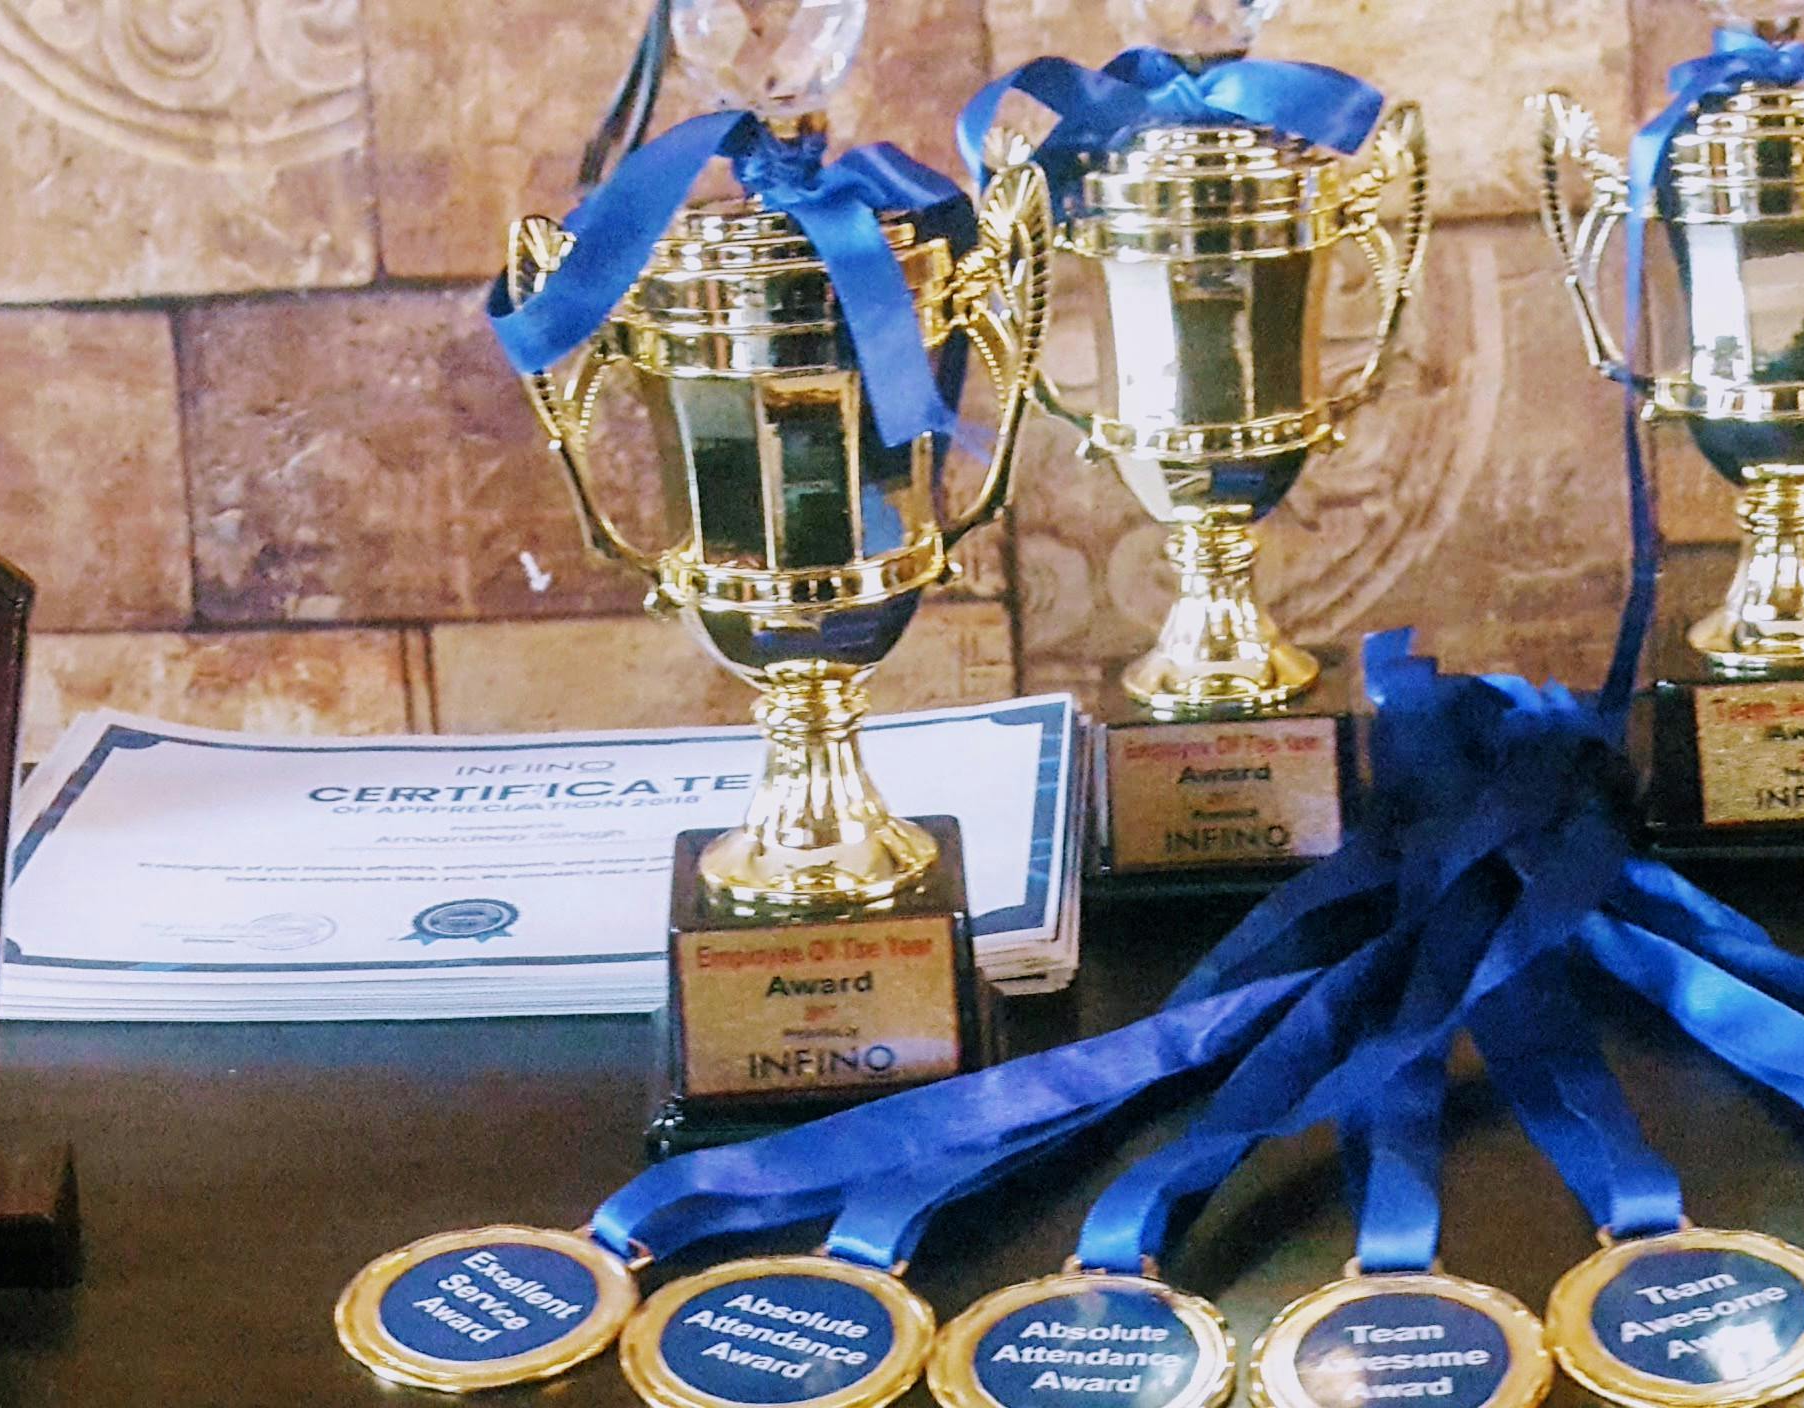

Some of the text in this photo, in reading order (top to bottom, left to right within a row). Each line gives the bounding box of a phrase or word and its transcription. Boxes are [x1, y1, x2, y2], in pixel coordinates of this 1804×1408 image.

[766, 971, 874, 998] Award
[748, 1044, 895, 1080] INFINO
[462, 1251, 583, 1319] Excellent
[1635, 1273, 1739, 1305] Team
[412, 1296, 502, 1342] Award
[724, 1294, 869, 1339] Absolute
[1019, 1321, 1169, 1342] Absolute
[1620, 1286, 1788, 1343] Awesome
[682, 1310, 868, 1365] Attendance
[1345, 1324, 1445, 1344] Team
[701, 1341, 812, 1379] Award
[991, 1344, 1184, 1368] Attendance
[1031, 1370, 1141, 1393] Award
